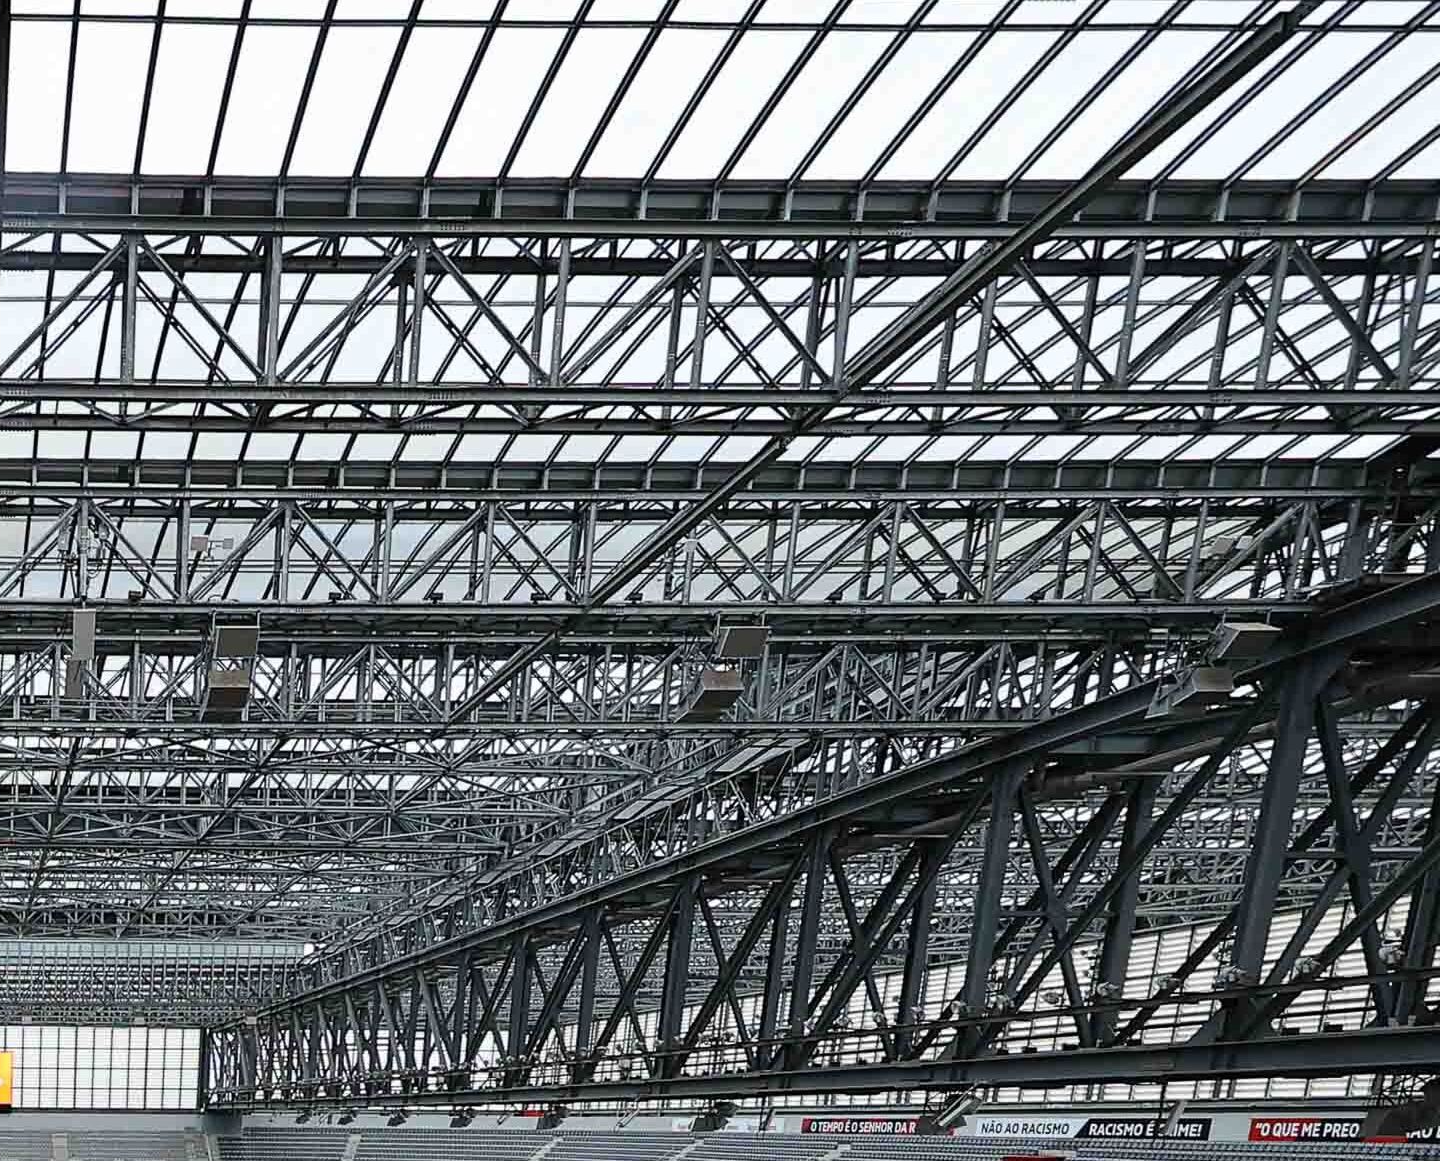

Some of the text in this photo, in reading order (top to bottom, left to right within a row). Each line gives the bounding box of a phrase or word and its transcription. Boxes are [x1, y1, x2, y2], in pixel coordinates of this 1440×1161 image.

[810, 1121, 817, 1132] O
[818, 1121, 844, 1133] TEMPO
[844, 1118, 851, 1133] É
[851, 1122, 858, 1133] O
[858, 1121, 893, 1133] SENHOR
[894, 1122, 907, 1134] DA
[981, 1119, 1070, 1135] NÃO AO RACISMO
[1089, 1123, 1143, 1136] RACISMO
[1145, 1120, 1155, 1136] É
[1272, 1122, 1299, 1138] QUE
[1300, 1123, 1321, 1137] ME
